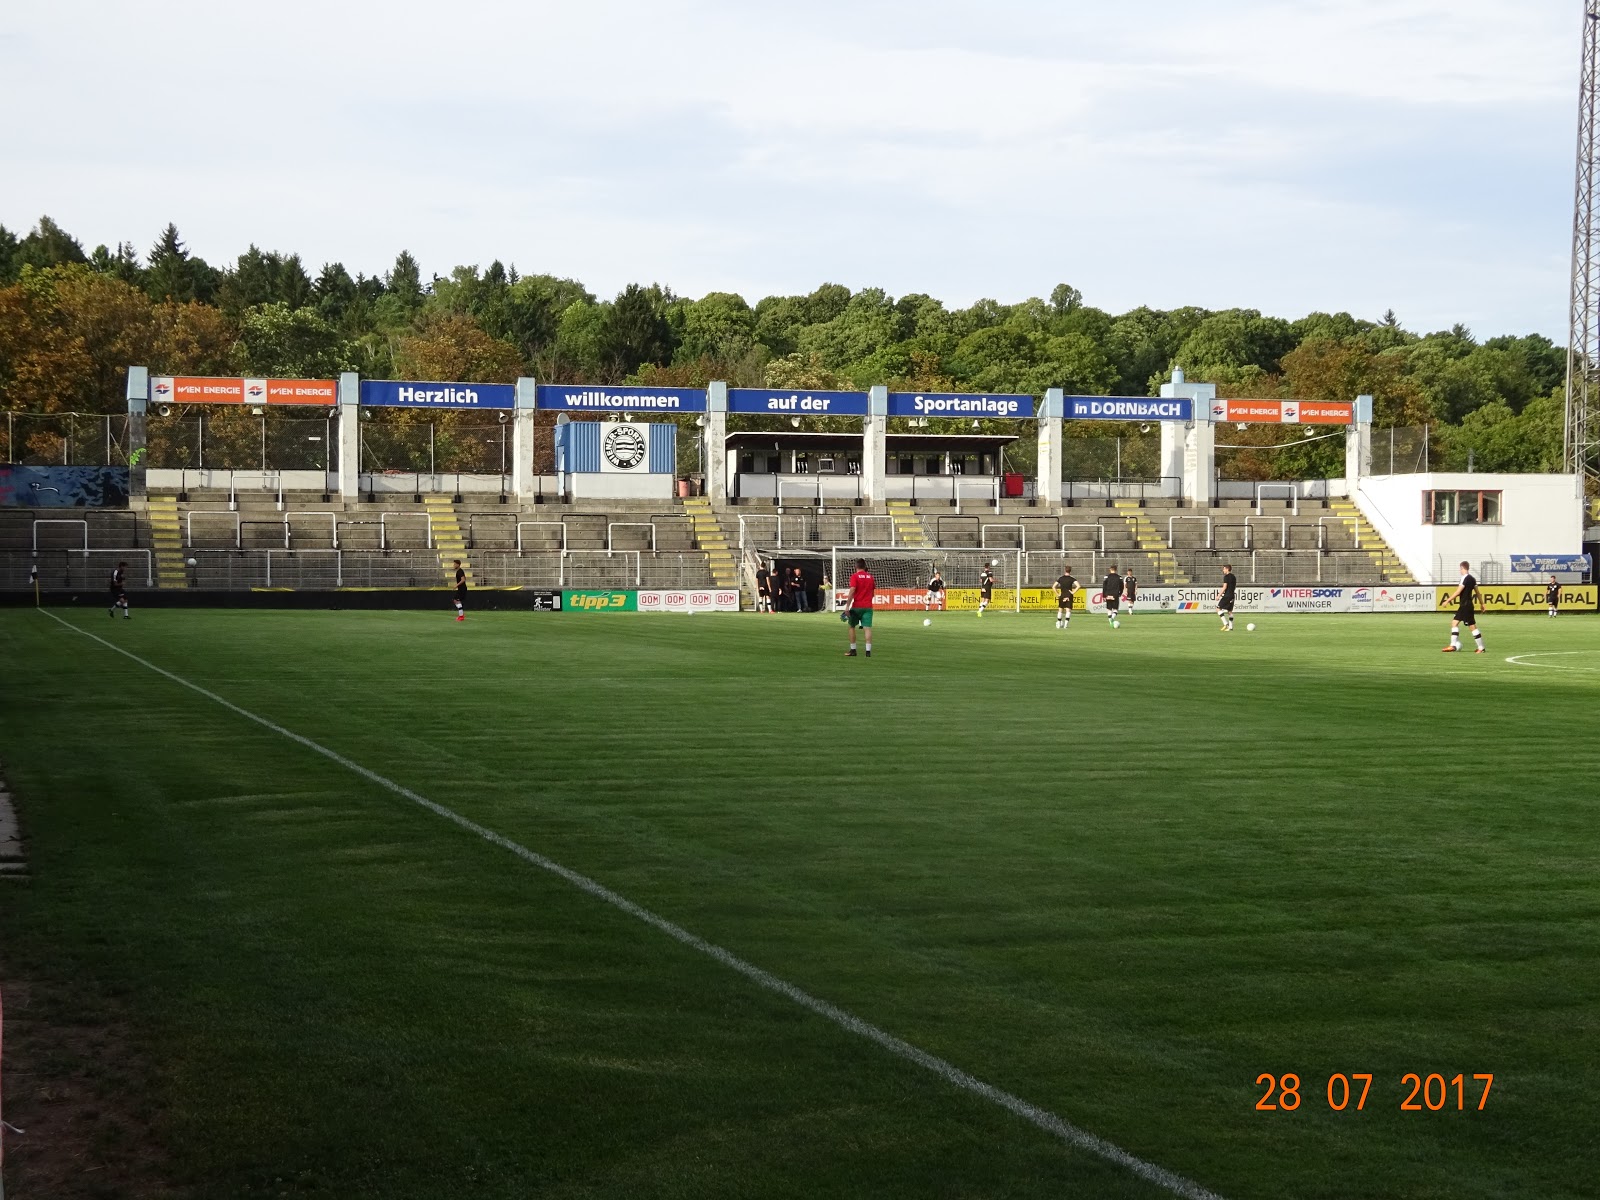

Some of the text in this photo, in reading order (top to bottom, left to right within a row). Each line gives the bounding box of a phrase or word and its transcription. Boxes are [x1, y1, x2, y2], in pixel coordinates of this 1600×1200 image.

[203, 386, 241, 395] ENERGIE
[295, 388, 332, 396] ENERGIE
[398, 387, 478, 404] Herzlich
[565, 391, 680, 408] willkommen
[767, 395, 831, 411] auf der
[914, 396, 1018, 416] Sportanlage
[1074, 401, 1181, 416] in DORNBACH
[1250, 408, 1279, 416] ENERGIE
[1321, 409, 1349, 417] ENERGIE
[630, 443, 645, 466] CLUB
[1177, 589, 1264, 604] Schmidläger
[1282, 588, 1343, 598] INTERSPORT
[1395, 590, 1433, 603] eyepin
[1286, 600, 1332, 609] WINNINGER
